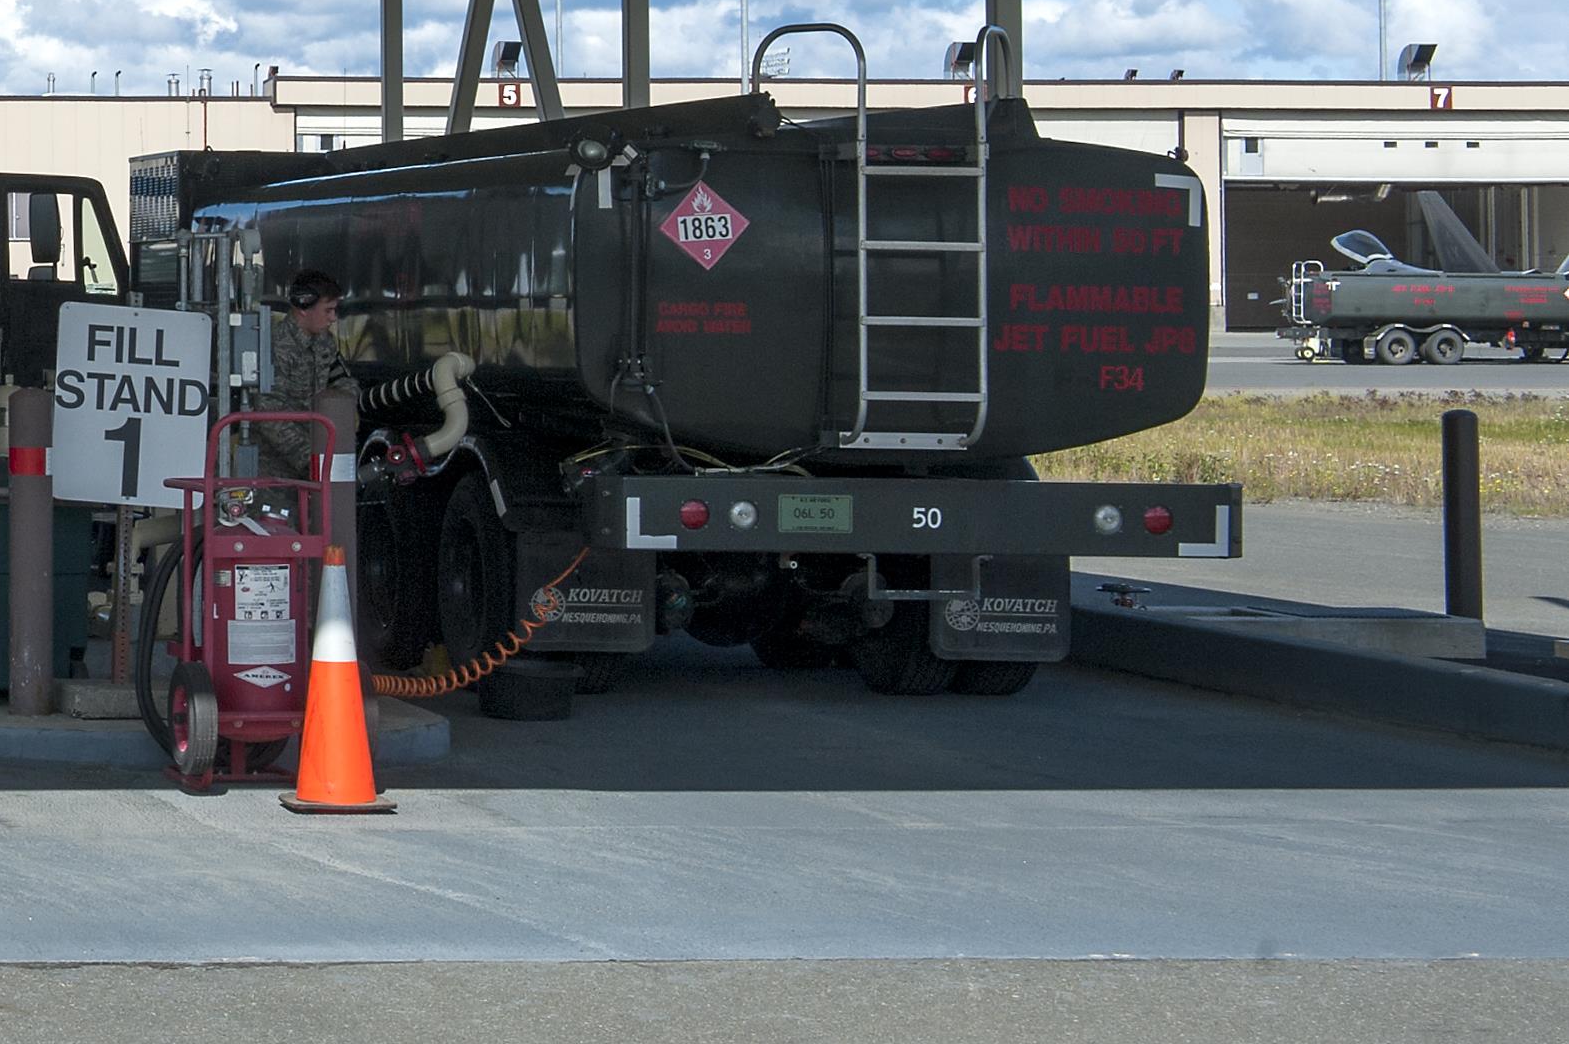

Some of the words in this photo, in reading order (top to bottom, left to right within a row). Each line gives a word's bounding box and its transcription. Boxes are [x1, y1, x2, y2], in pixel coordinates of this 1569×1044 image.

[502, 84, 517, 105] 5
[1433, 87, 1449, 108] 7
[1008, 186, 1049, 213] NO
[1059, 186, 1183, 217] SMOKING
[680, 215, 730, 240] 1863
[1007, 224, 1101, 253] WITHIN
[1112, 227, 1147, 254] 50
[1151, 228, 1184, 253] FT
[703, 248, 712, 260] 3
[1009, 283, 1184, 313] FLAMMABLE
[87, 324, 180, 368] FILL
[993, 324, 1049, 352] JET
[1060, 325, 1136, 353] FUEL
[1144, 326, 1196, 354] JP8
[1100, 365, 1145, 392] F34
[55, 369, 209, 417] STAND
[104, 417, 142, 498] 1
[819, 507, 835, 520] 50
[912, 507, 942, 529] 50
[567, 588, 643, 603] KOVATCH
[981, 597, 1058, 613] KOVATCH
